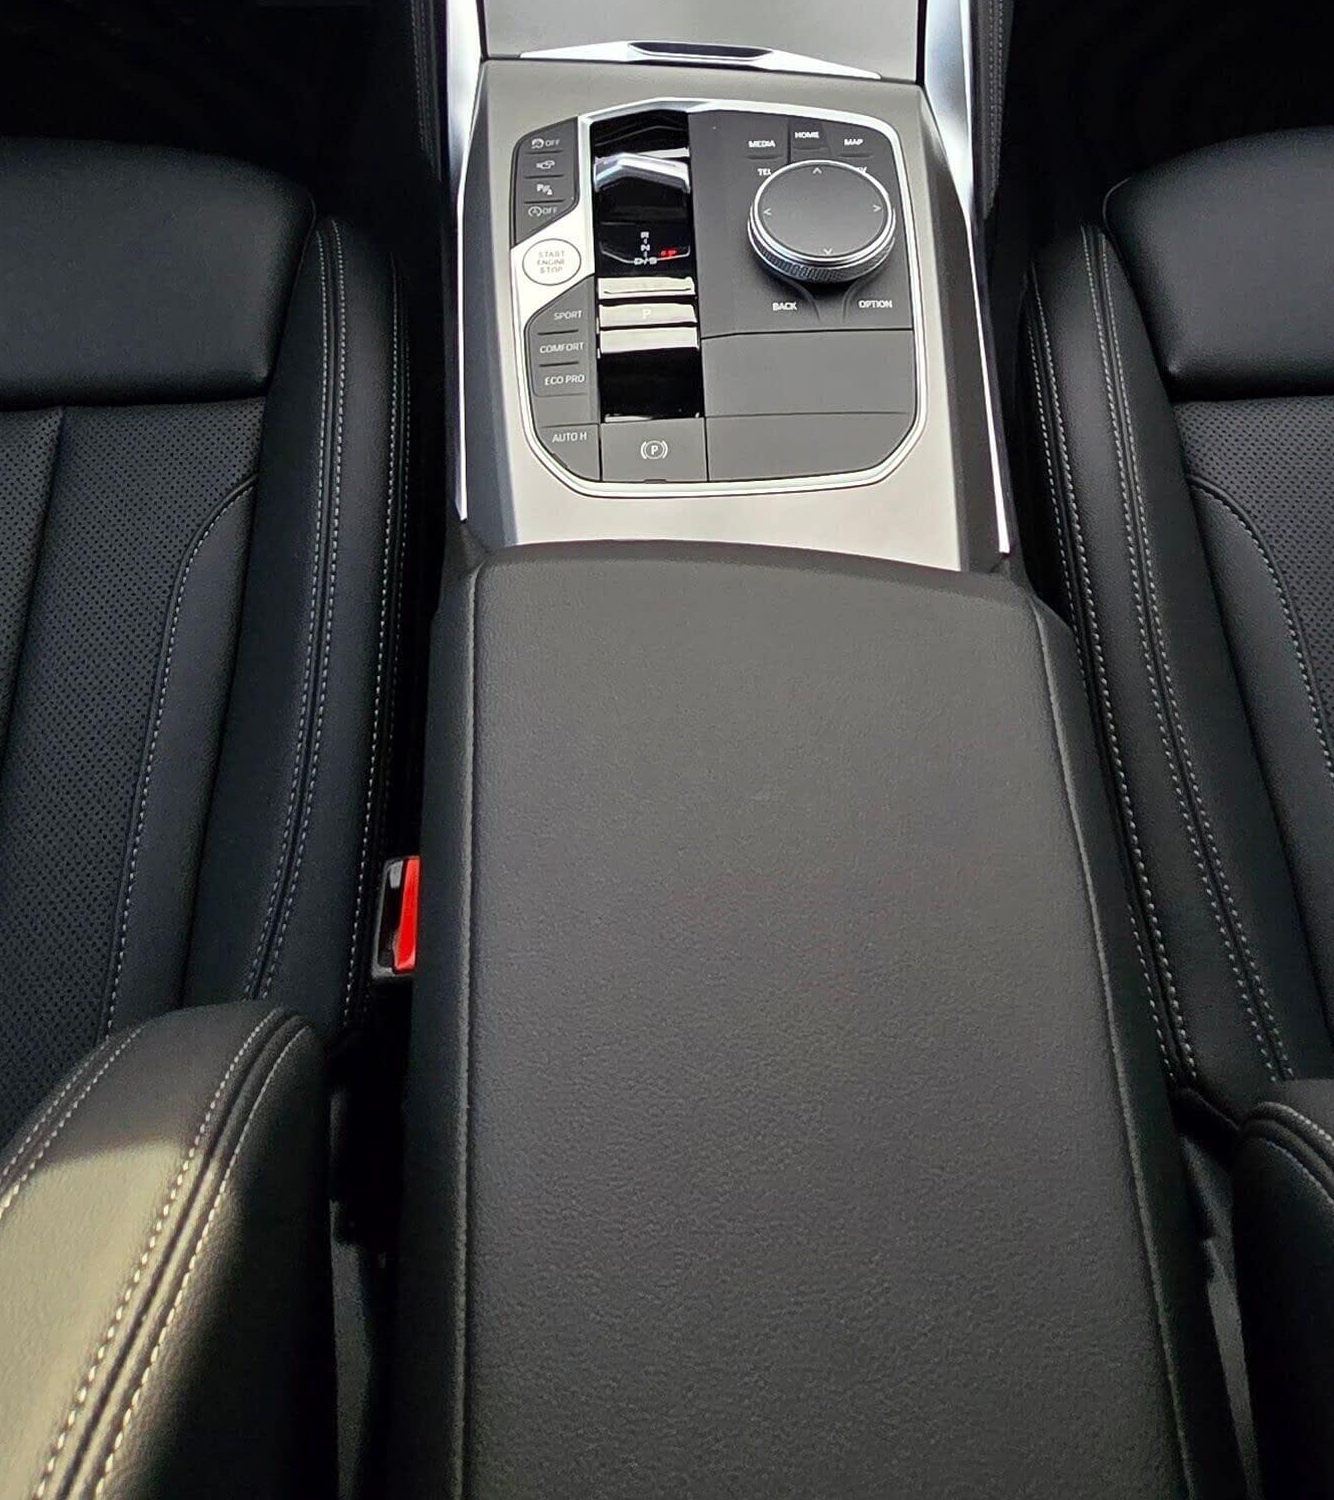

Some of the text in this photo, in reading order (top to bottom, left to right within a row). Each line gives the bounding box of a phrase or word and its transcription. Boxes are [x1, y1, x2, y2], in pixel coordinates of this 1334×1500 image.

[794, 131, 820, 139] HOME
[544, 138, 560, 147] OFF
[748, 140, 776, 148] MEDIA
[843, 138, 864, 146] MAP
[542, 207, 558, 216] OFF
[538, 250, 566, 259] START
[536, 258, 566, 267] ENGINE
[539, 266, 564, 275] STOP
[772, 301, 798, 311] BACK
[858, 299, 893, 309] OPTION
[553, 309, 583, 320] SPORT
[539, 341, 585, 354] COMFORT
[544, 374, 586, 386] ECO PRO
[551, 431, 588, 444] AUTO H
